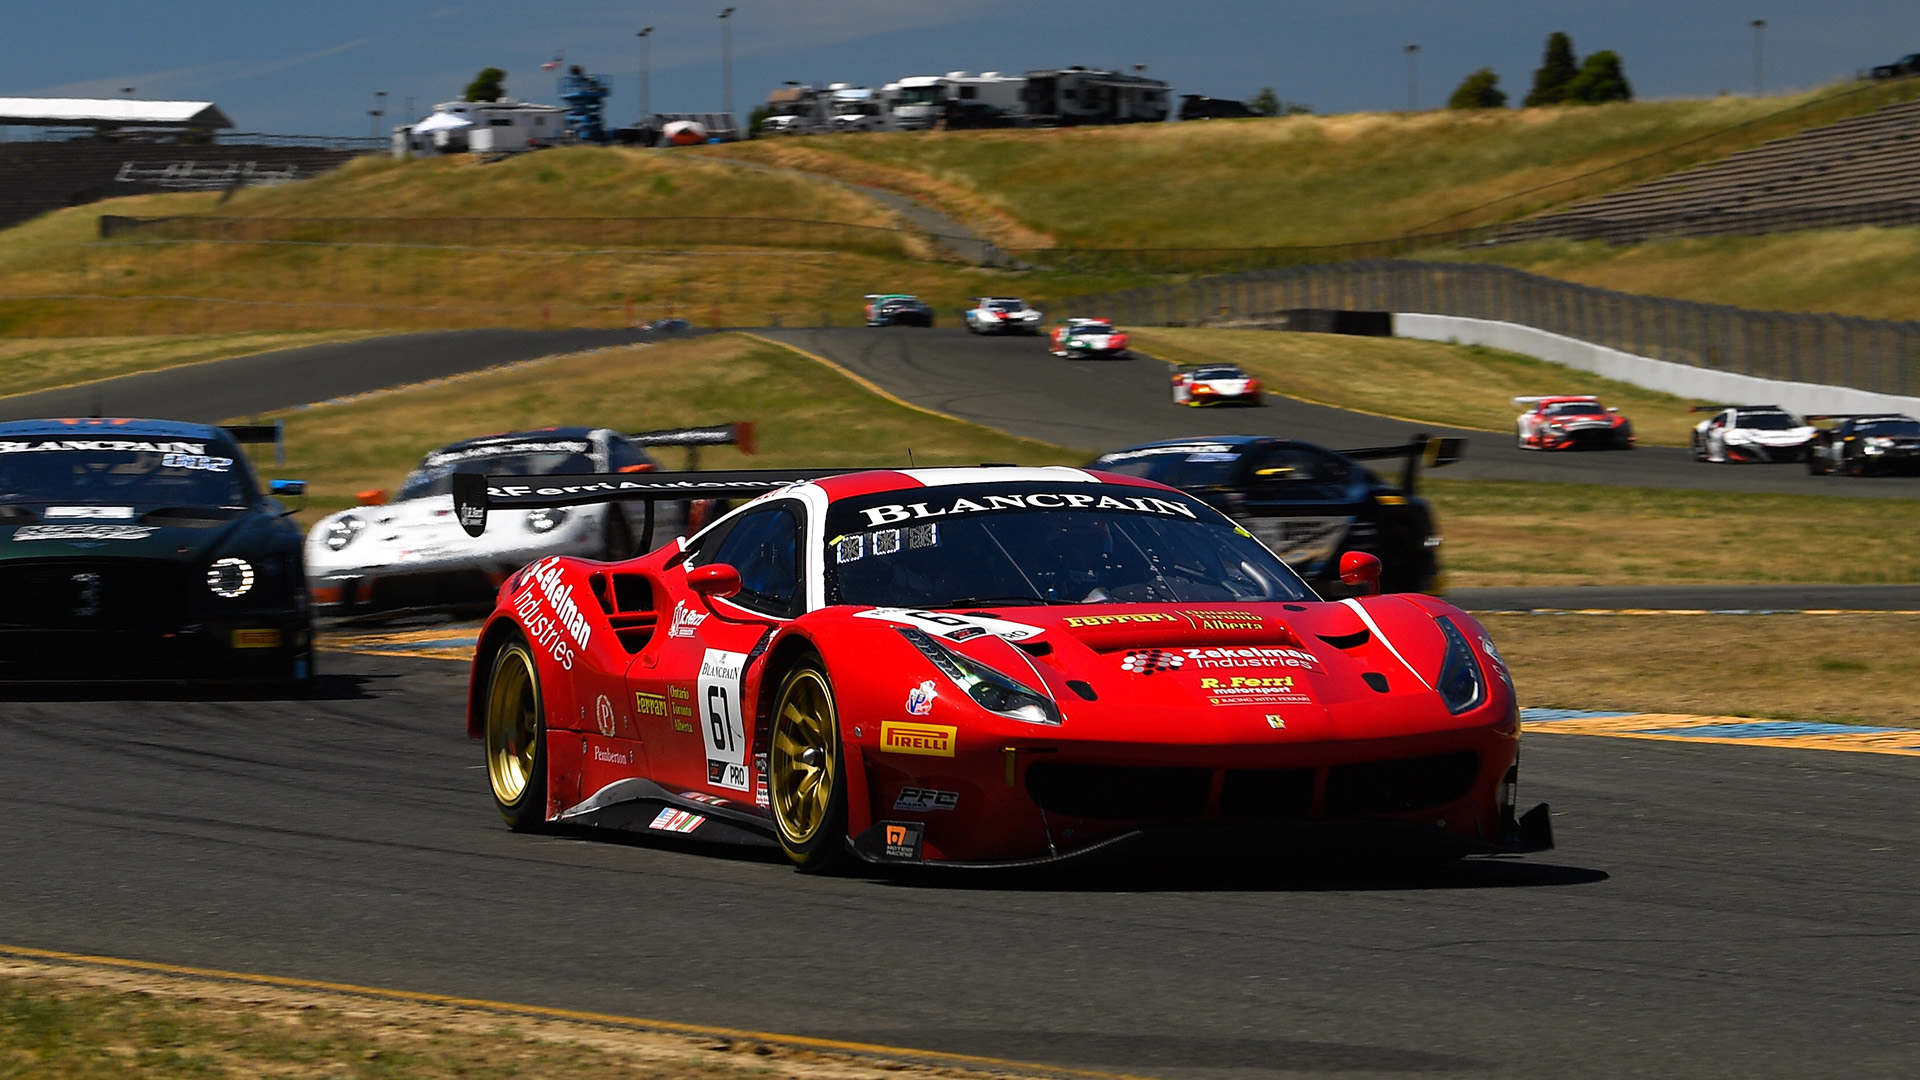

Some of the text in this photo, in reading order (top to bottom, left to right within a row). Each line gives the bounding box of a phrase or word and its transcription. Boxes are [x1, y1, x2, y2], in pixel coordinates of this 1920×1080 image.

[859, 494, 1197, 527] BLANCPAIN
[535, 556, 592, 652] Zekelman
[513, 582, 575, 671] Industries
[1063, 613, 1178, 628] Ferrari
[1203, 620, 1263, 630] Alberta
[1182, 647, 1319, 664] Zekelman
[1196, 656, 1313, 670] Industries
[702, 662, 740, 680] BLANCPAIN
[1201, 676, 1294, 689] R. Ferri
[1213, 686, 1291, 695] motorsport
[670, 684, 690, 700] Ontario
[636, 691, 667, 716] Ferrari
[672, 701, 692, 717] Toronto
[674, 718, 693, 733] Alberta
[707, 685, 736, 752] 61
[886, 727, 949, 751] PIRELLI
[594, 745, 627, 765] Pemberton
[729, 765, 745, 786] PRO
